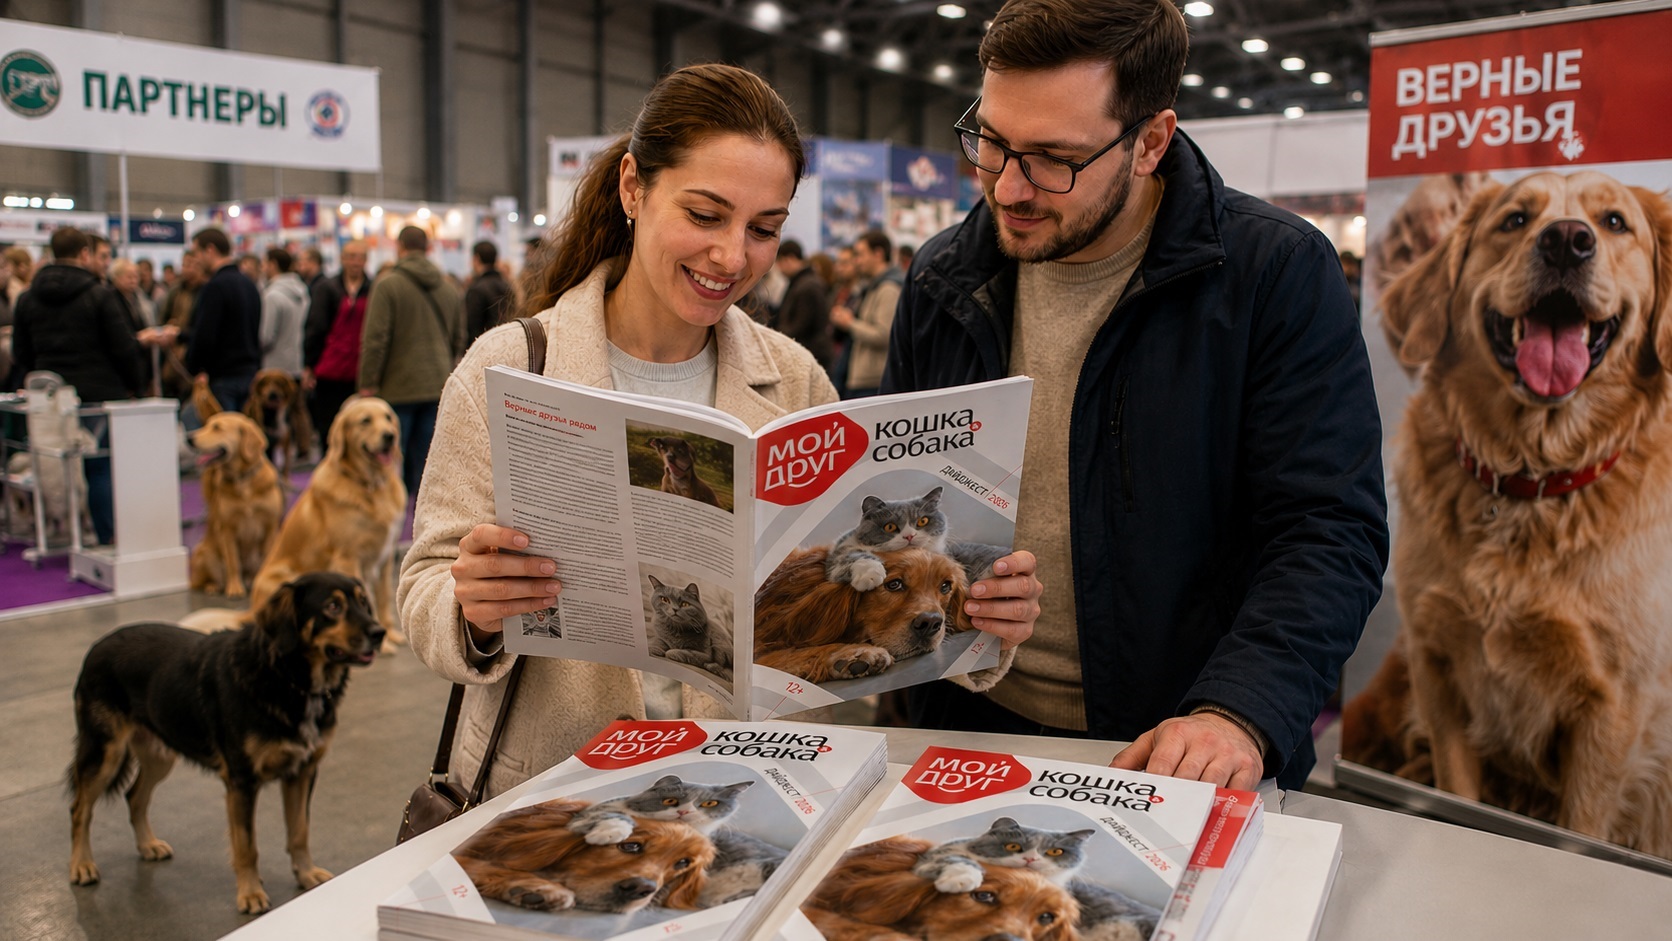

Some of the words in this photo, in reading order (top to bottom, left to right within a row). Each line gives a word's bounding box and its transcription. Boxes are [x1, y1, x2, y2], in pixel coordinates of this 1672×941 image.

[1396, 49, 1583, 107] ВЕРНЫЕ
[83, 70, 287, 128] ПАРТНЕРЫ
[1391, 100, 1575, 161] ДРУЗЬЯ
[875, 408, 974, 441] кошка
[872, 431, 975, 463] собака
[785, 681, 804, 695] 12+
[700, 742, 819, 762] собака
[713, 730, 829, 748] кошка
[1029, 784, 1152, 812] собака
[1037, 769, 1157, 797] кошка
